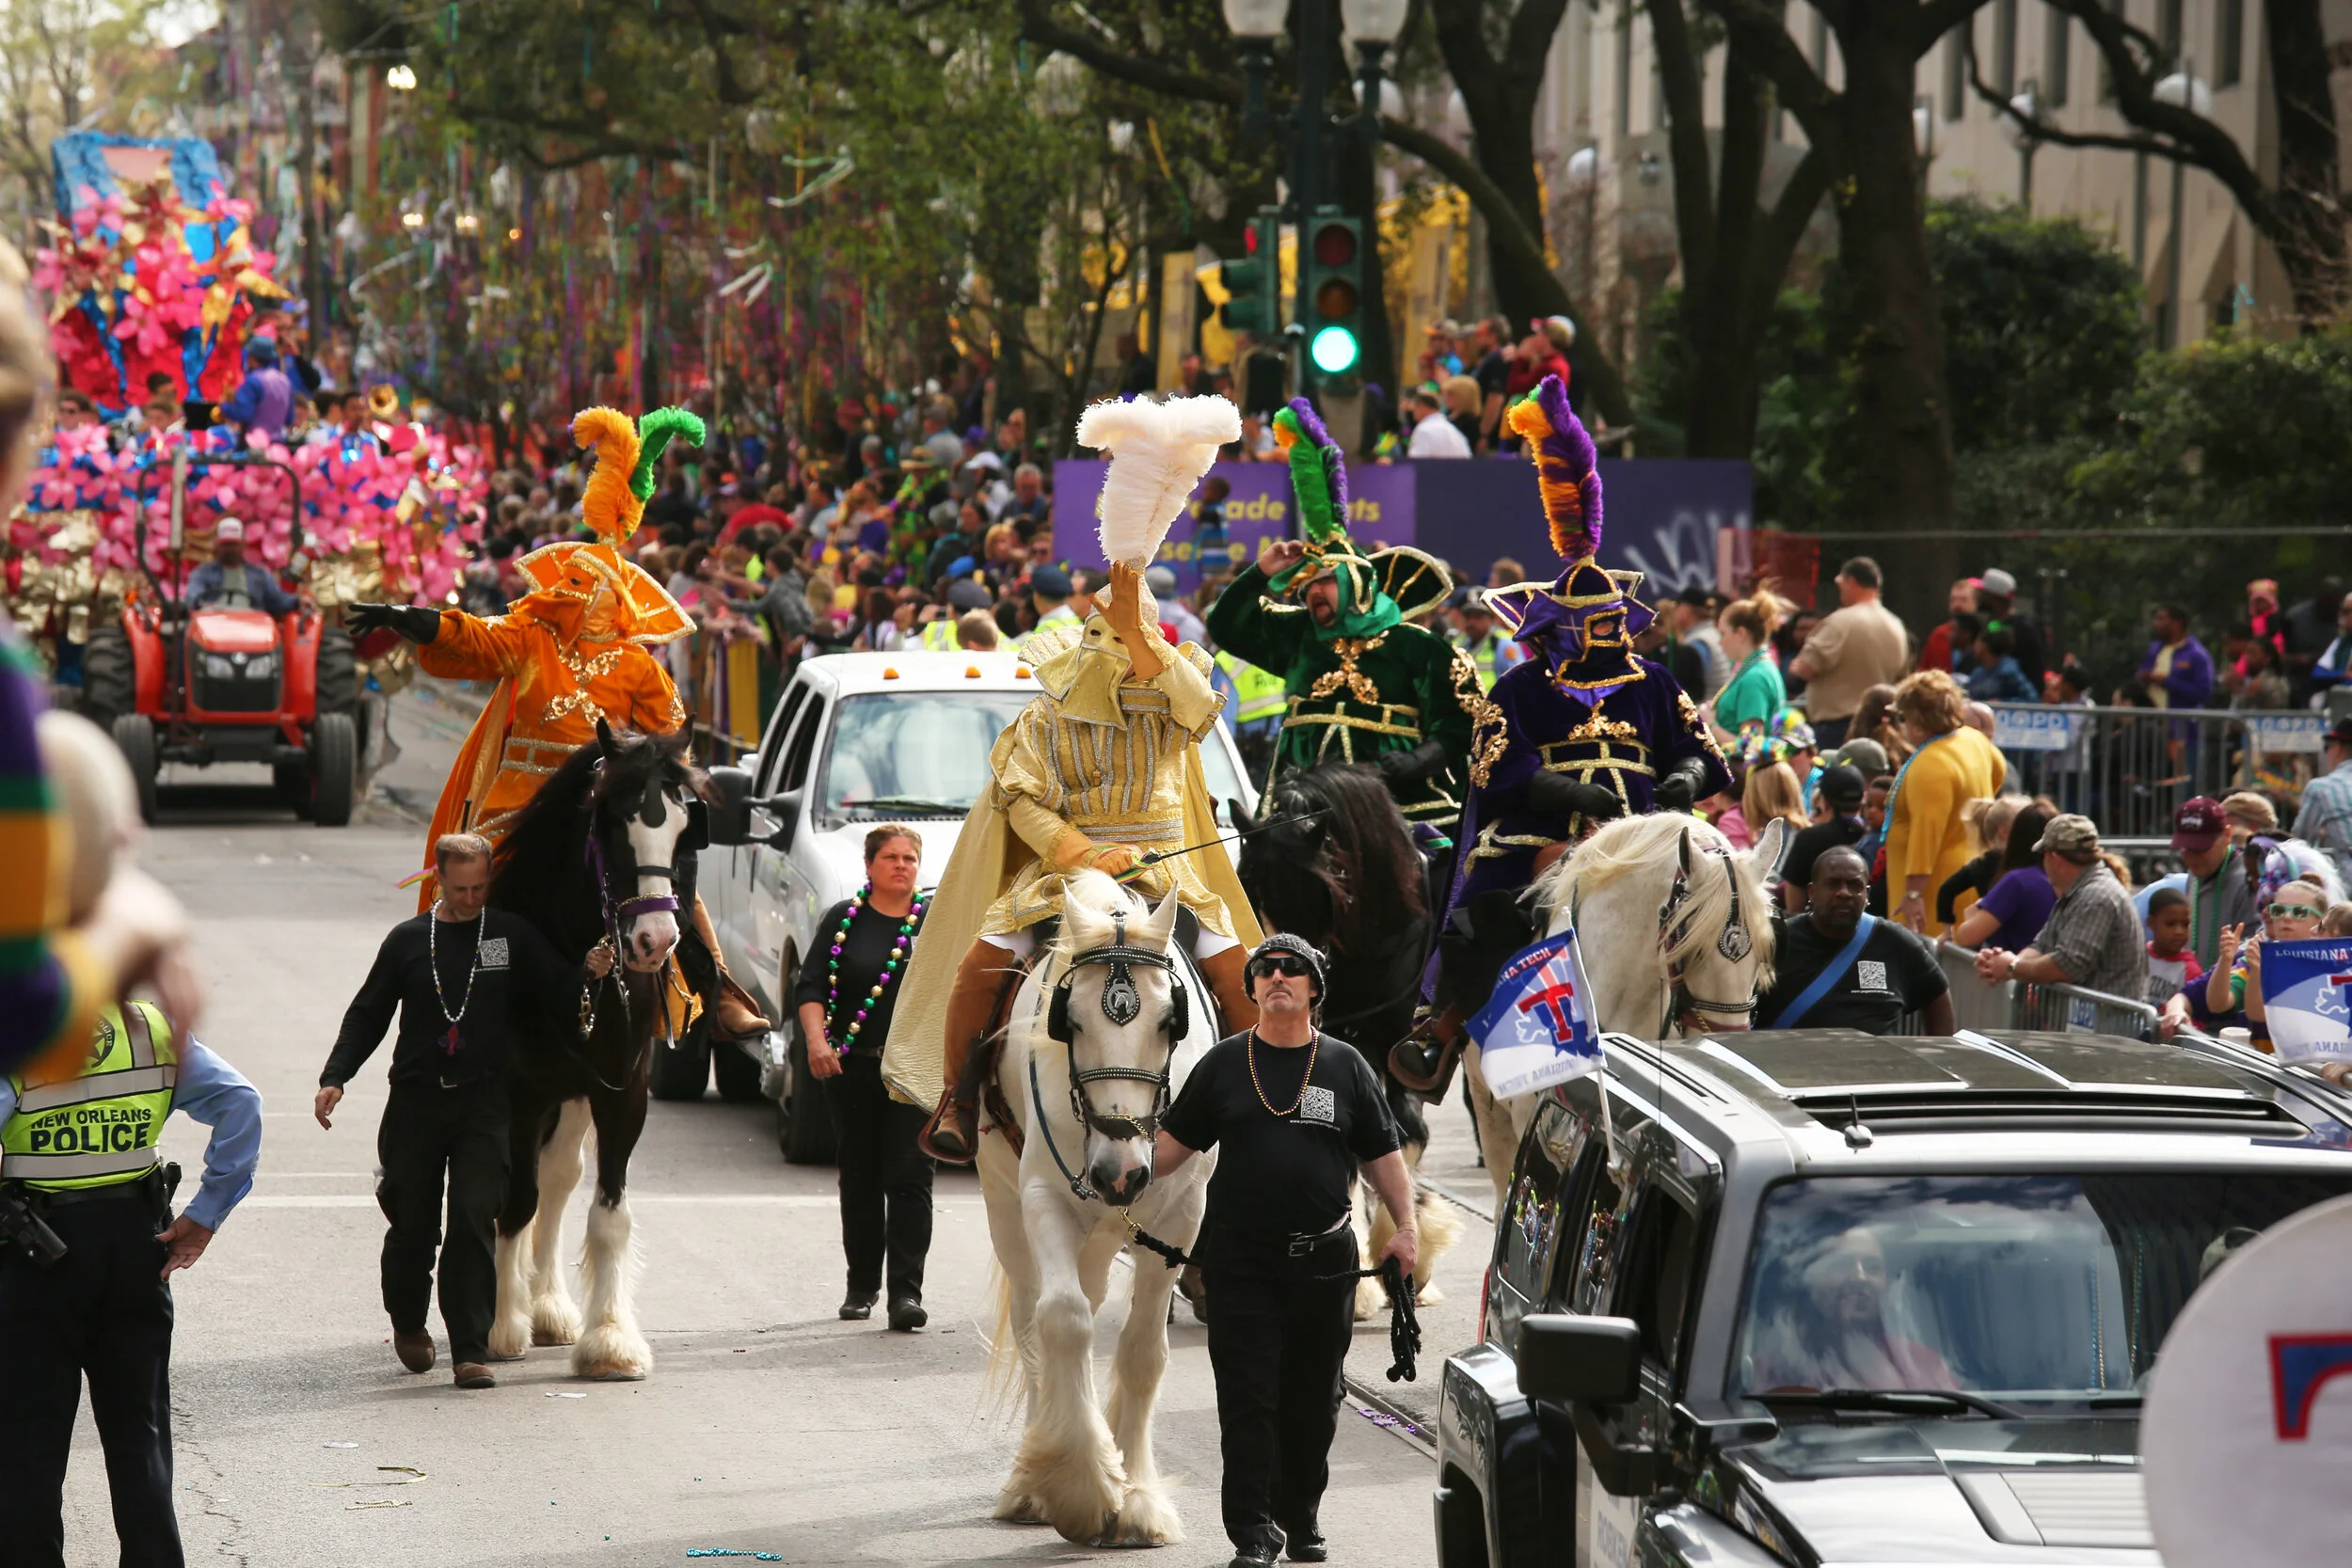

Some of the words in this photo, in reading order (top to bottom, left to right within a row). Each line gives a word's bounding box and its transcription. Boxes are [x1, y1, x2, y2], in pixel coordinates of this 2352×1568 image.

[1517, 946, 1552, 969] TECH
[96, 1020, 113, 1047] OLICE
[31, 1112, 72, 1130] NEW
[75, 1108, 151, 1125] ORLEANS
[30, 1122, 151, 1153] POLICE
